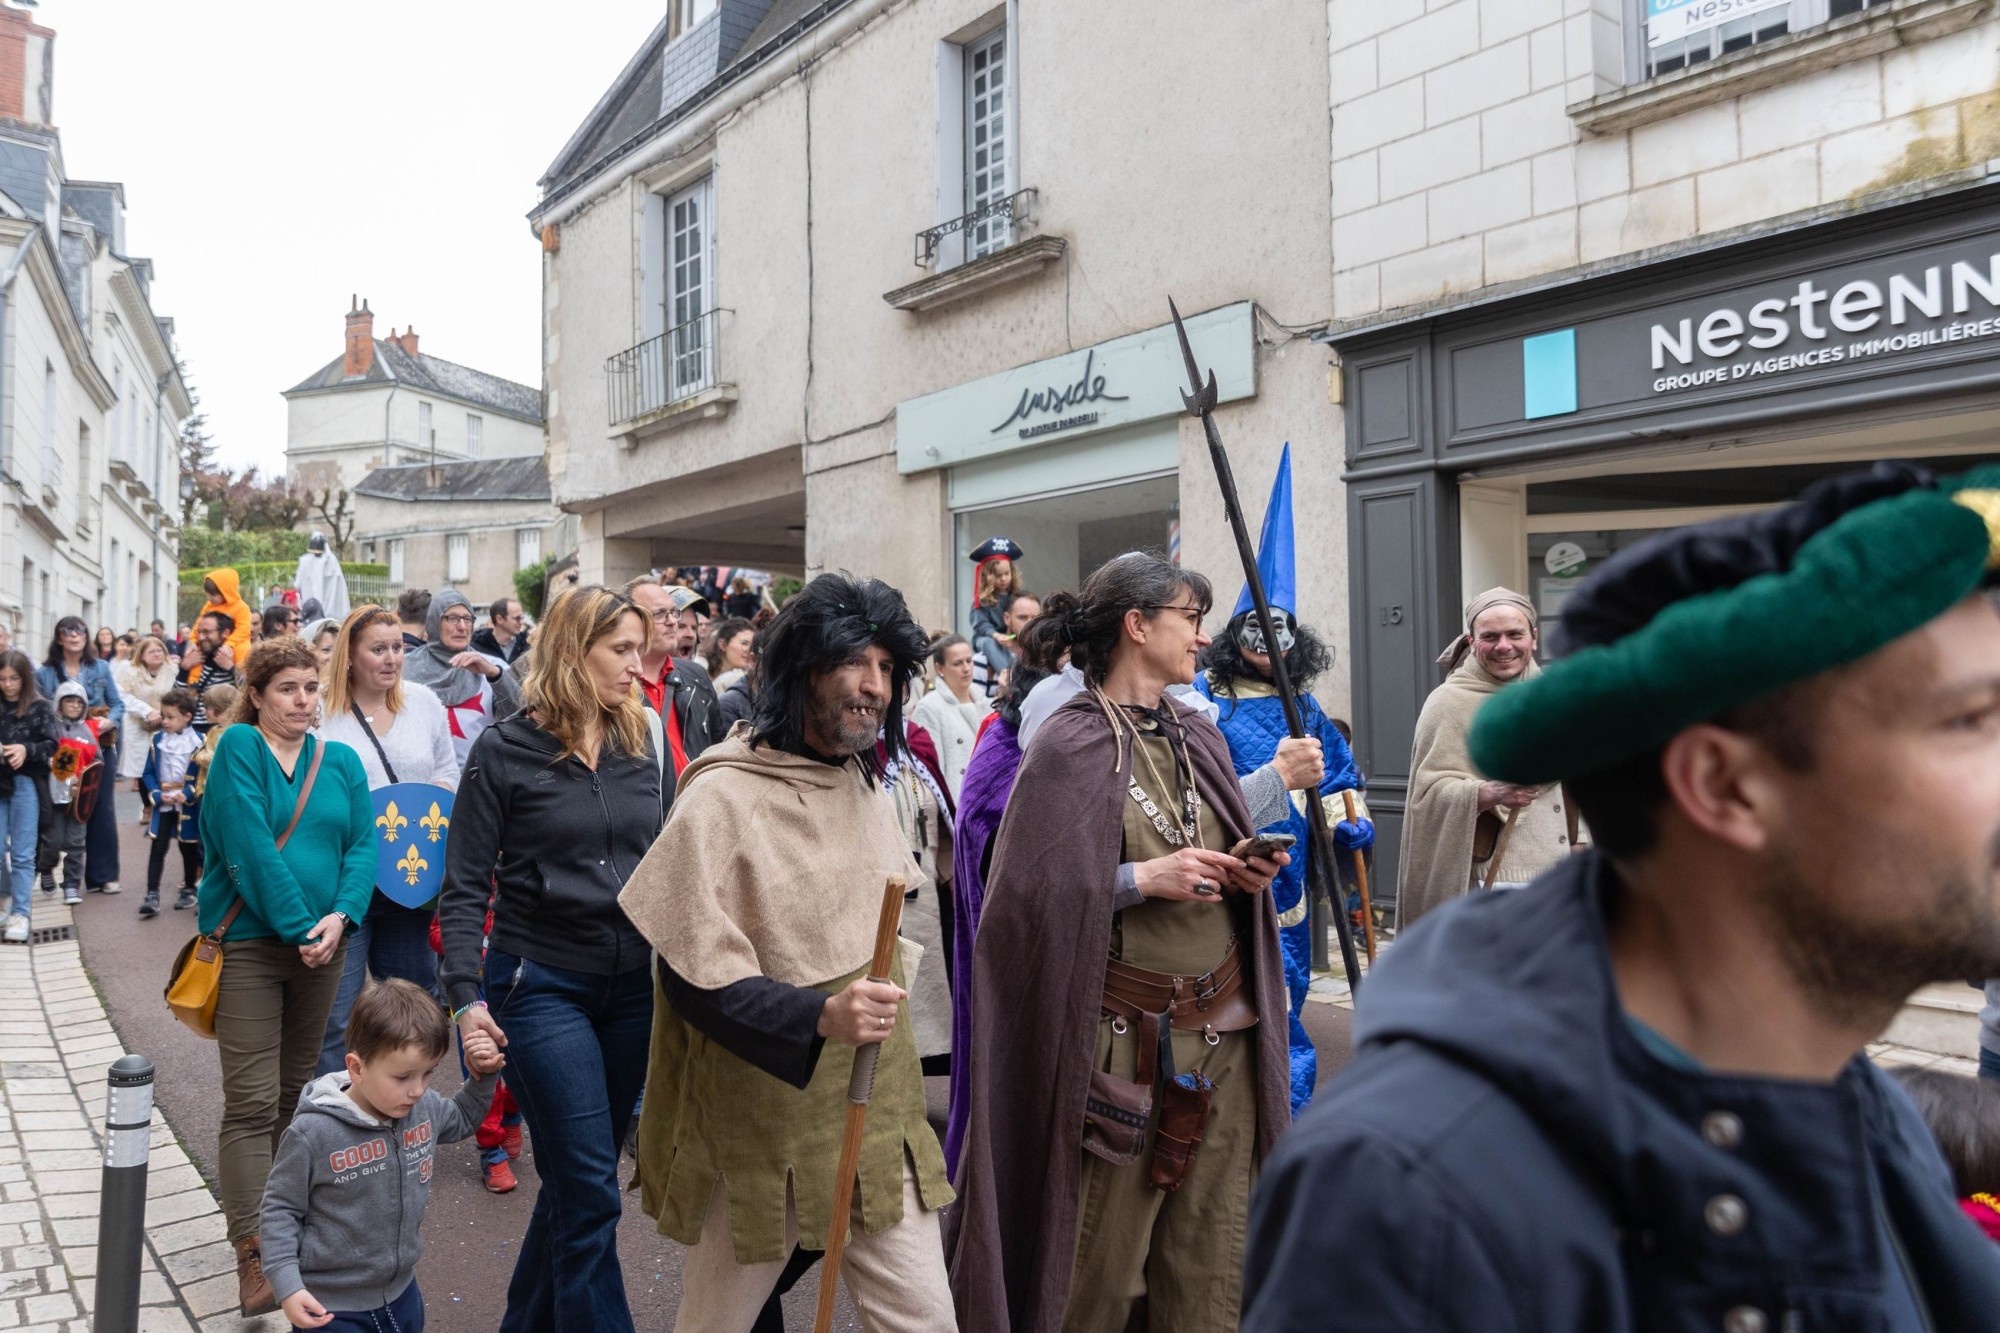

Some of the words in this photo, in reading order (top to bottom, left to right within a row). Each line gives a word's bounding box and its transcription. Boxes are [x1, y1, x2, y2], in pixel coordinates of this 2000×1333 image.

[1653, 366, 1728, 393] GROUPE
[1732, 347, 1845, 379] D'AGENCES
[1849, 316, 2000, 358] IMMOBILIÈRES
[1380, 604, 1403, 627] 15
[330, 1138, 387, 1173] GOOD
[334, 1172, 358, 1184] AND
[362, 1162, 387, 1175] GIVE
[405, 1150, 420, 1161] THE
